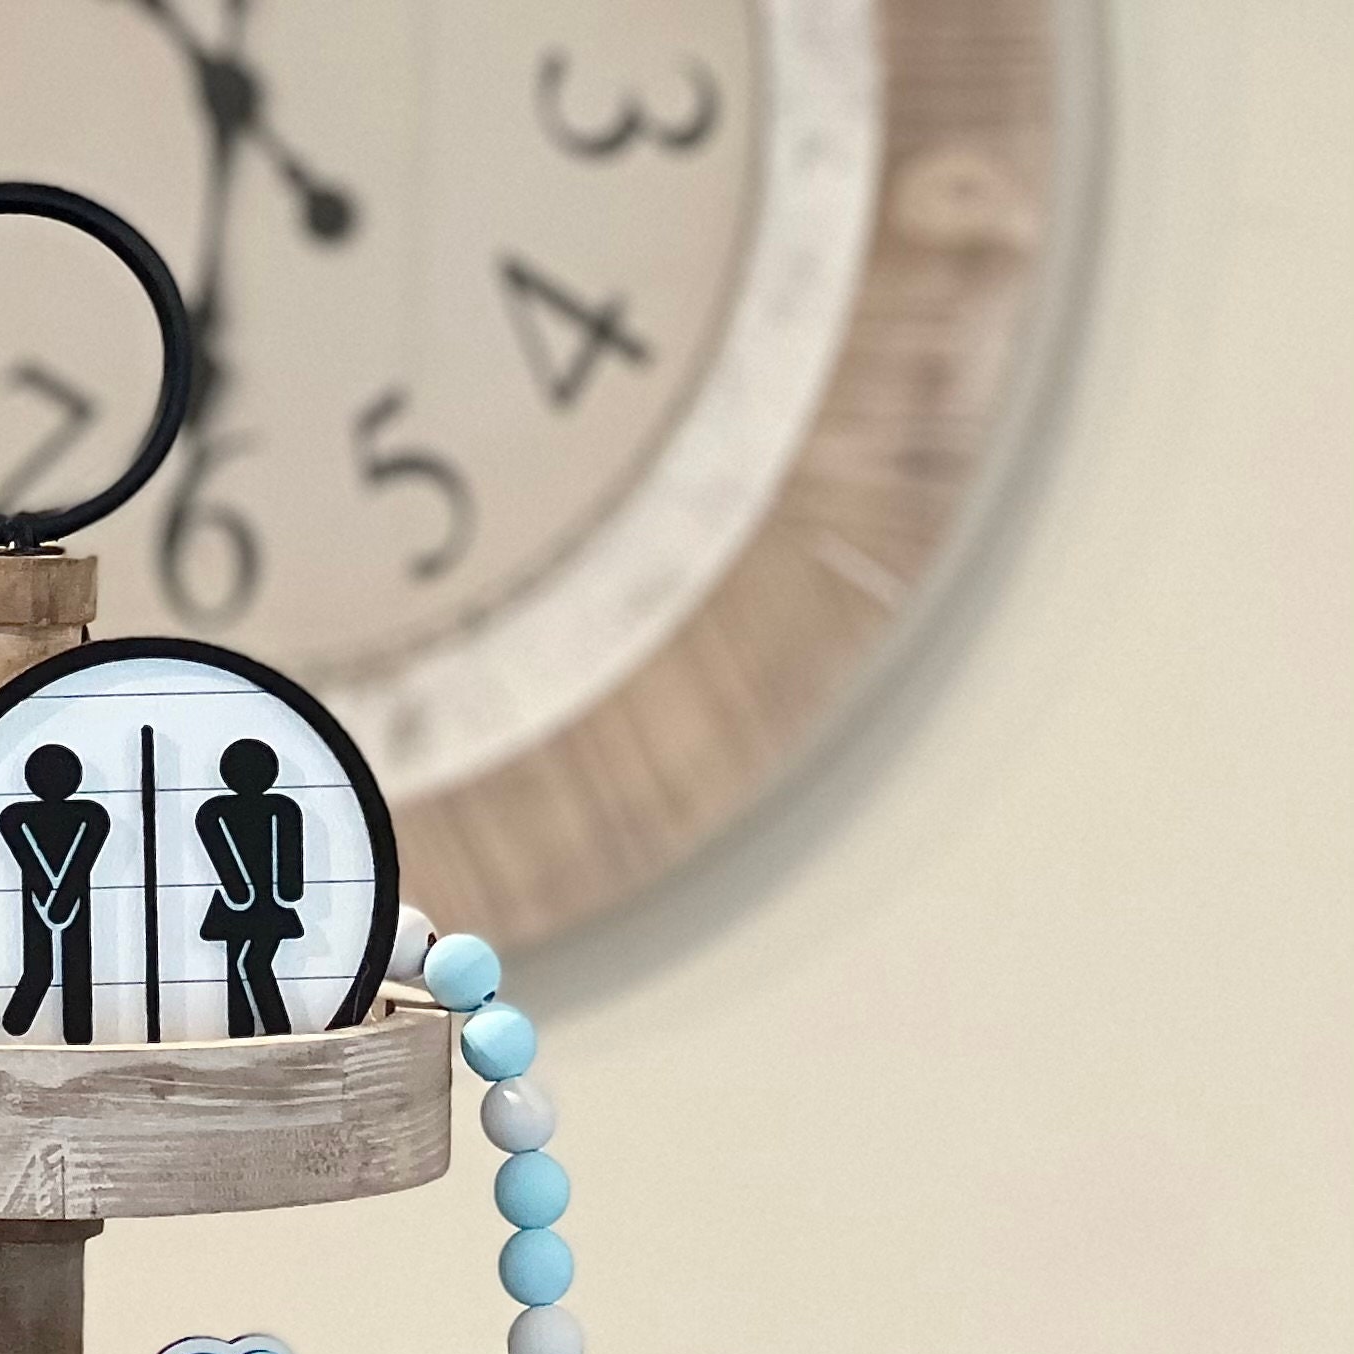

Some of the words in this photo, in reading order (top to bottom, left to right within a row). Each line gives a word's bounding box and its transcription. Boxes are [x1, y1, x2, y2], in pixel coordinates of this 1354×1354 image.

[534, 48, 719, 160] 3
[498, 250, 651, 410] 4
[159, 430, 264, 632] 6
[353, 388, 477, 580] 5
